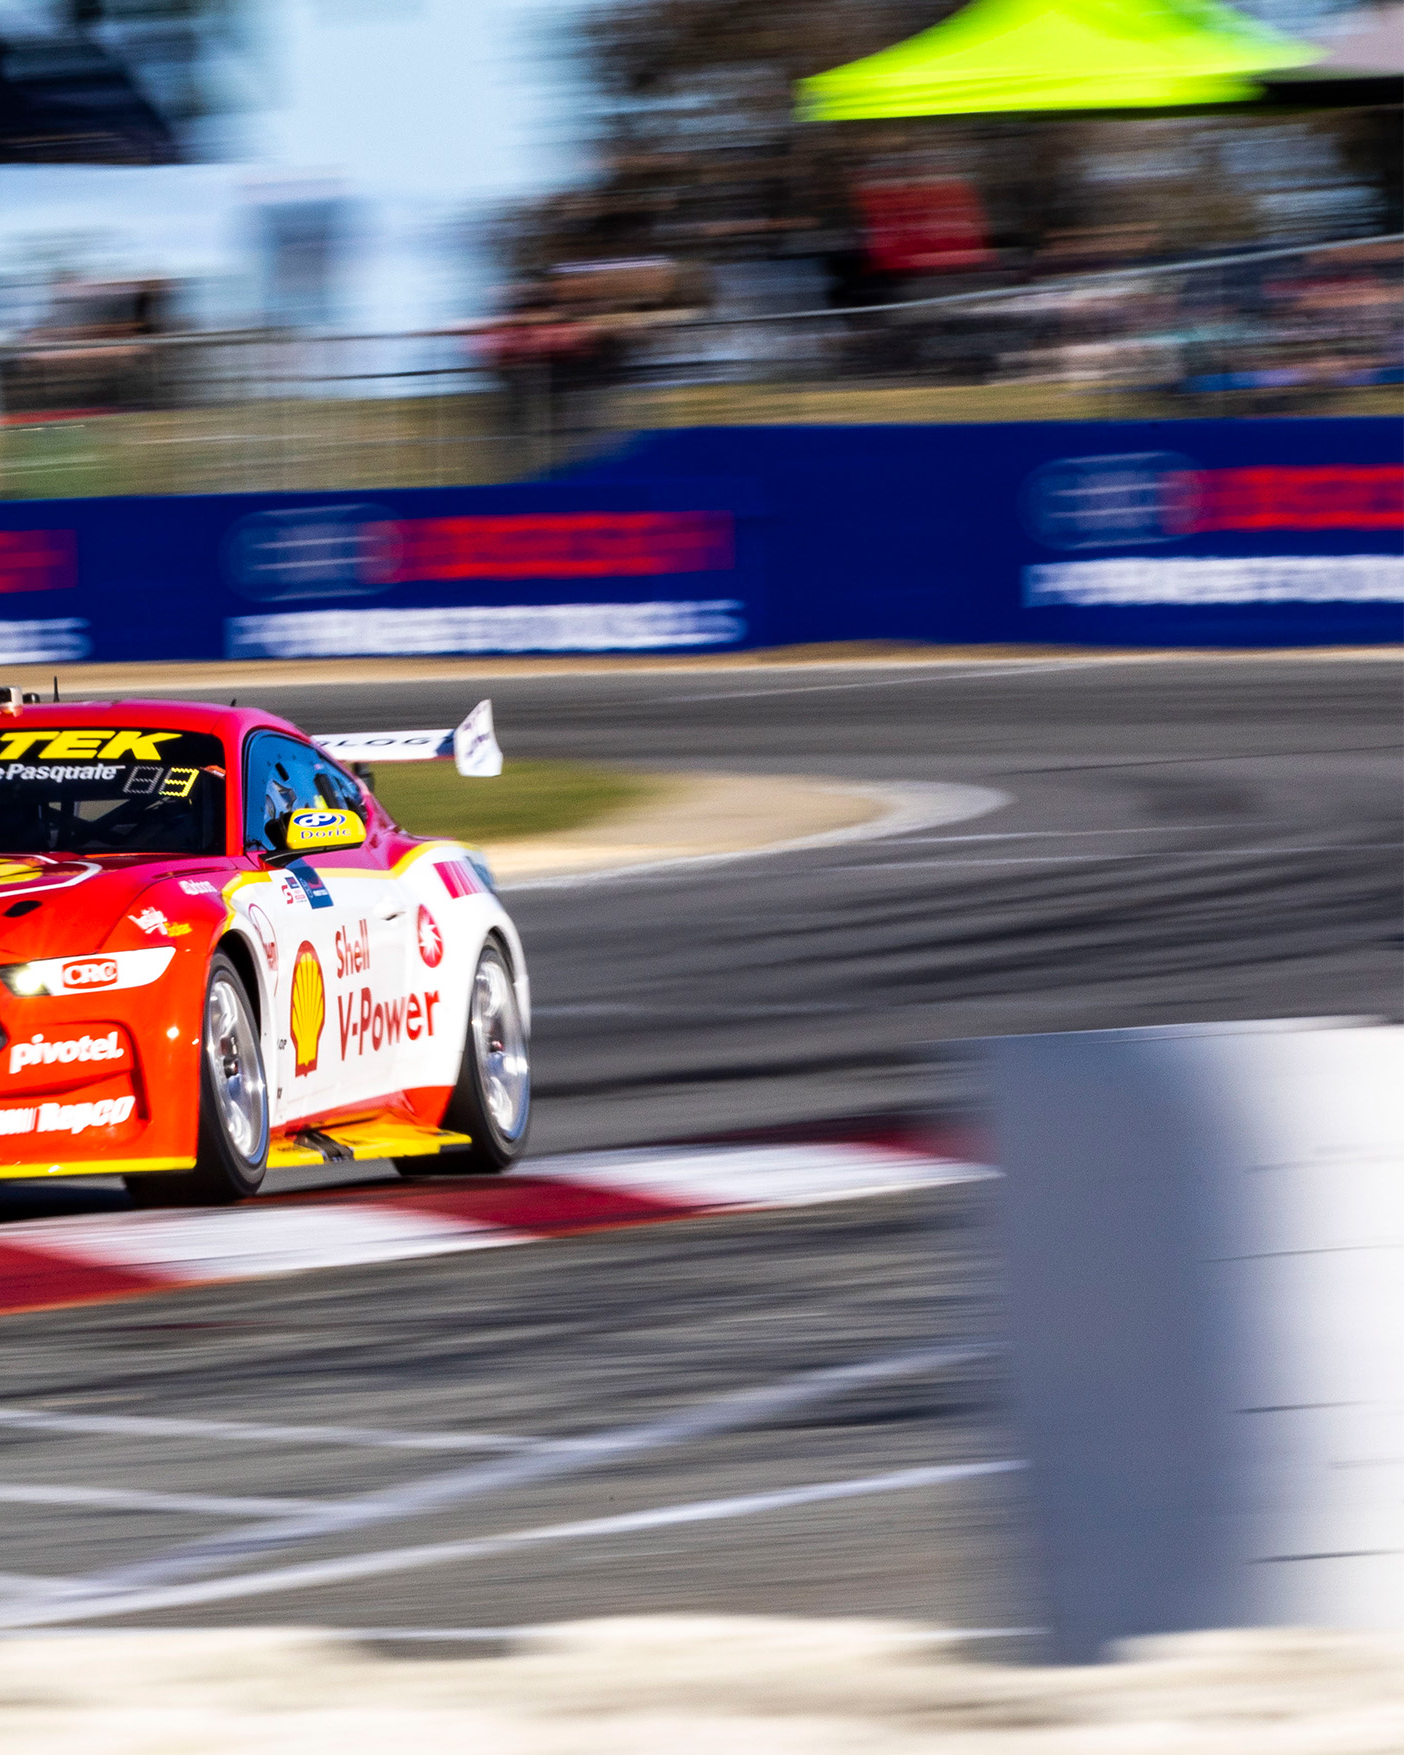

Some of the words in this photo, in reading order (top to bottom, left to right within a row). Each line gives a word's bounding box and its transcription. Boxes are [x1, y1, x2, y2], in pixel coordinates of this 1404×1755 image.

[301, 827, 352, 840] Doric
[335, 918, 370, 979] Shell
[63, 961, 117, 985] CRC
[337, 986, 441, 1062] V-Power
